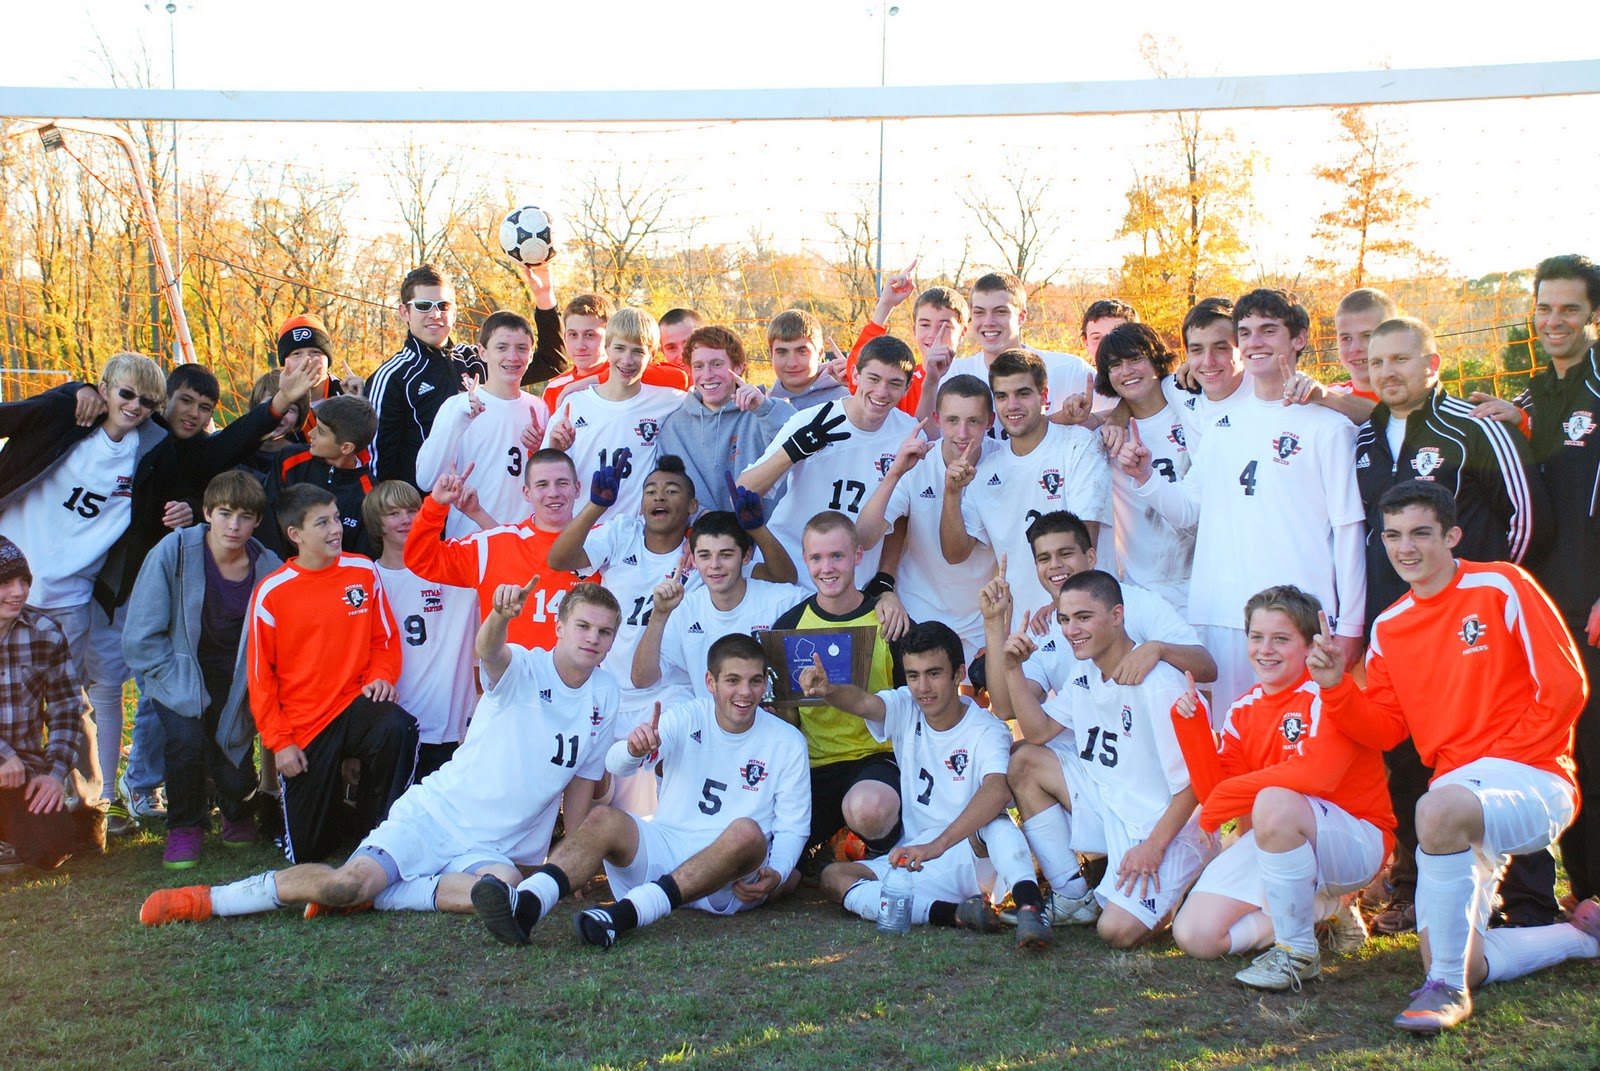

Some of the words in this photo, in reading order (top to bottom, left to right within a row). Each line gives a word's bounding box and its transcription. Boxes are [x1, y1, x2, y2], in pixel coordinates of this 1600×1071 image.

[507, 446, 522, 477] 3
[1239, 460, 1258, 496] 4
[62, 486, 108, 518] 15
[828, 478, 866, 514] 17
[343, 517, 358, 528] 25
[532, 589, 566, 622] 14
[404, 614, 427, 646] 9
[551, 733, 579, 768] 11
[1080, 726, 1118, 768] 15
[698, 778, 728, 816] 5
